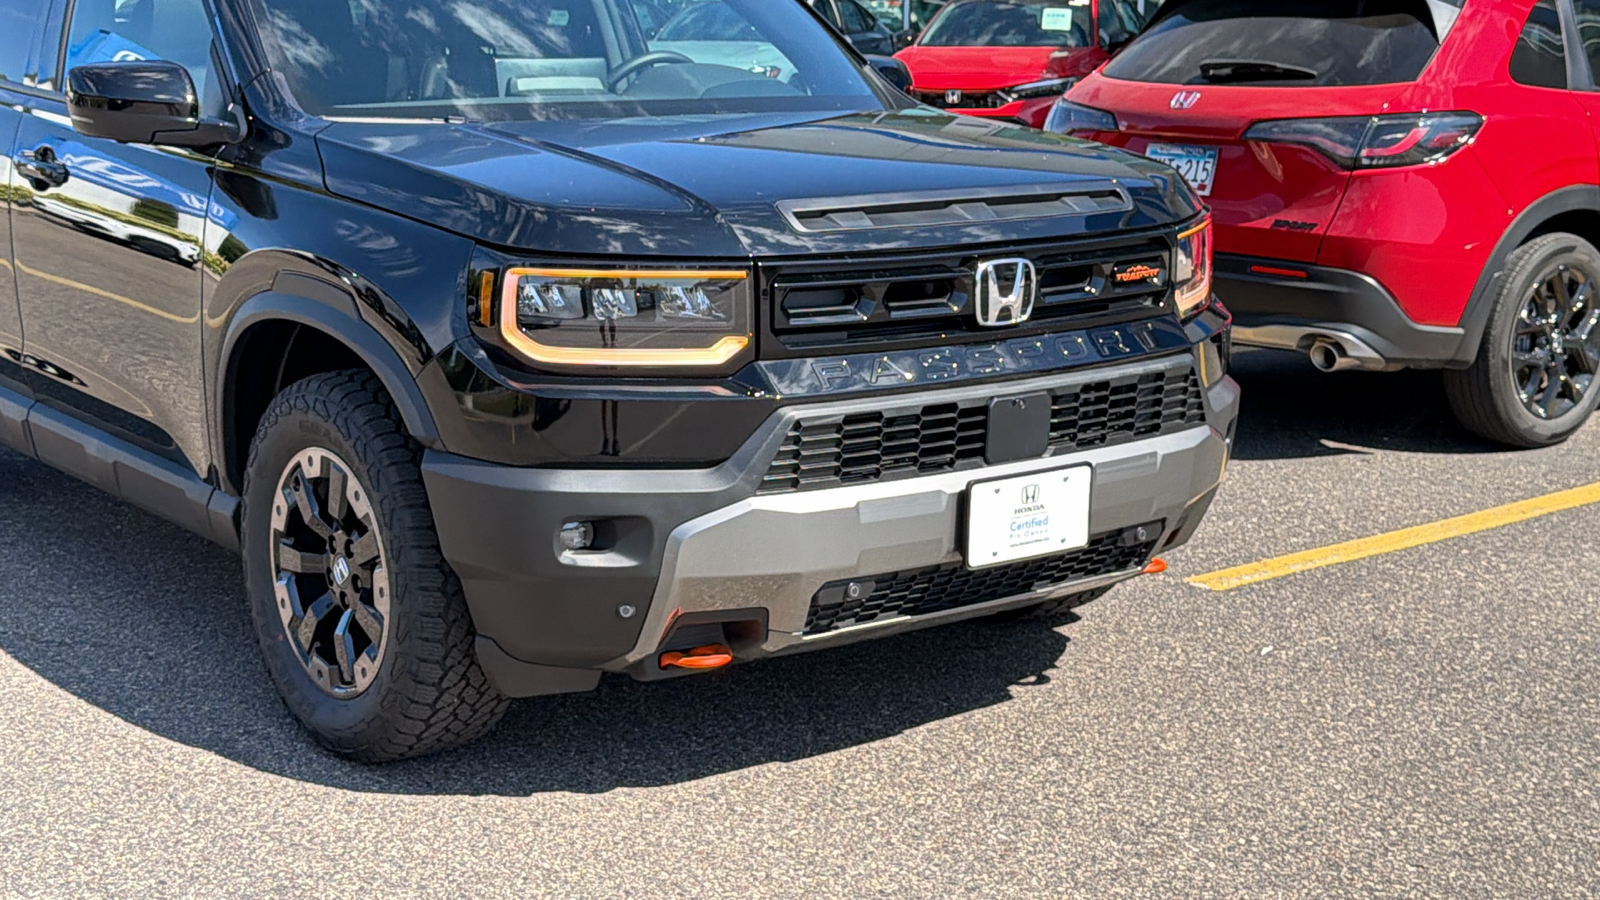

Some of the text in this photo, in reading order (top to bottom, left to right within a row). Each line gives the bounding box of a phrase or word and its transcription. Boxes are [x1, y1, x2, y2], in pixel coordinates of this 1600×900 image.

[810, 323, 1155, 391] PASSPORT
[1014, 504, 1045, 514] HONDA
[1010, 515, 1048, 531] Certified
